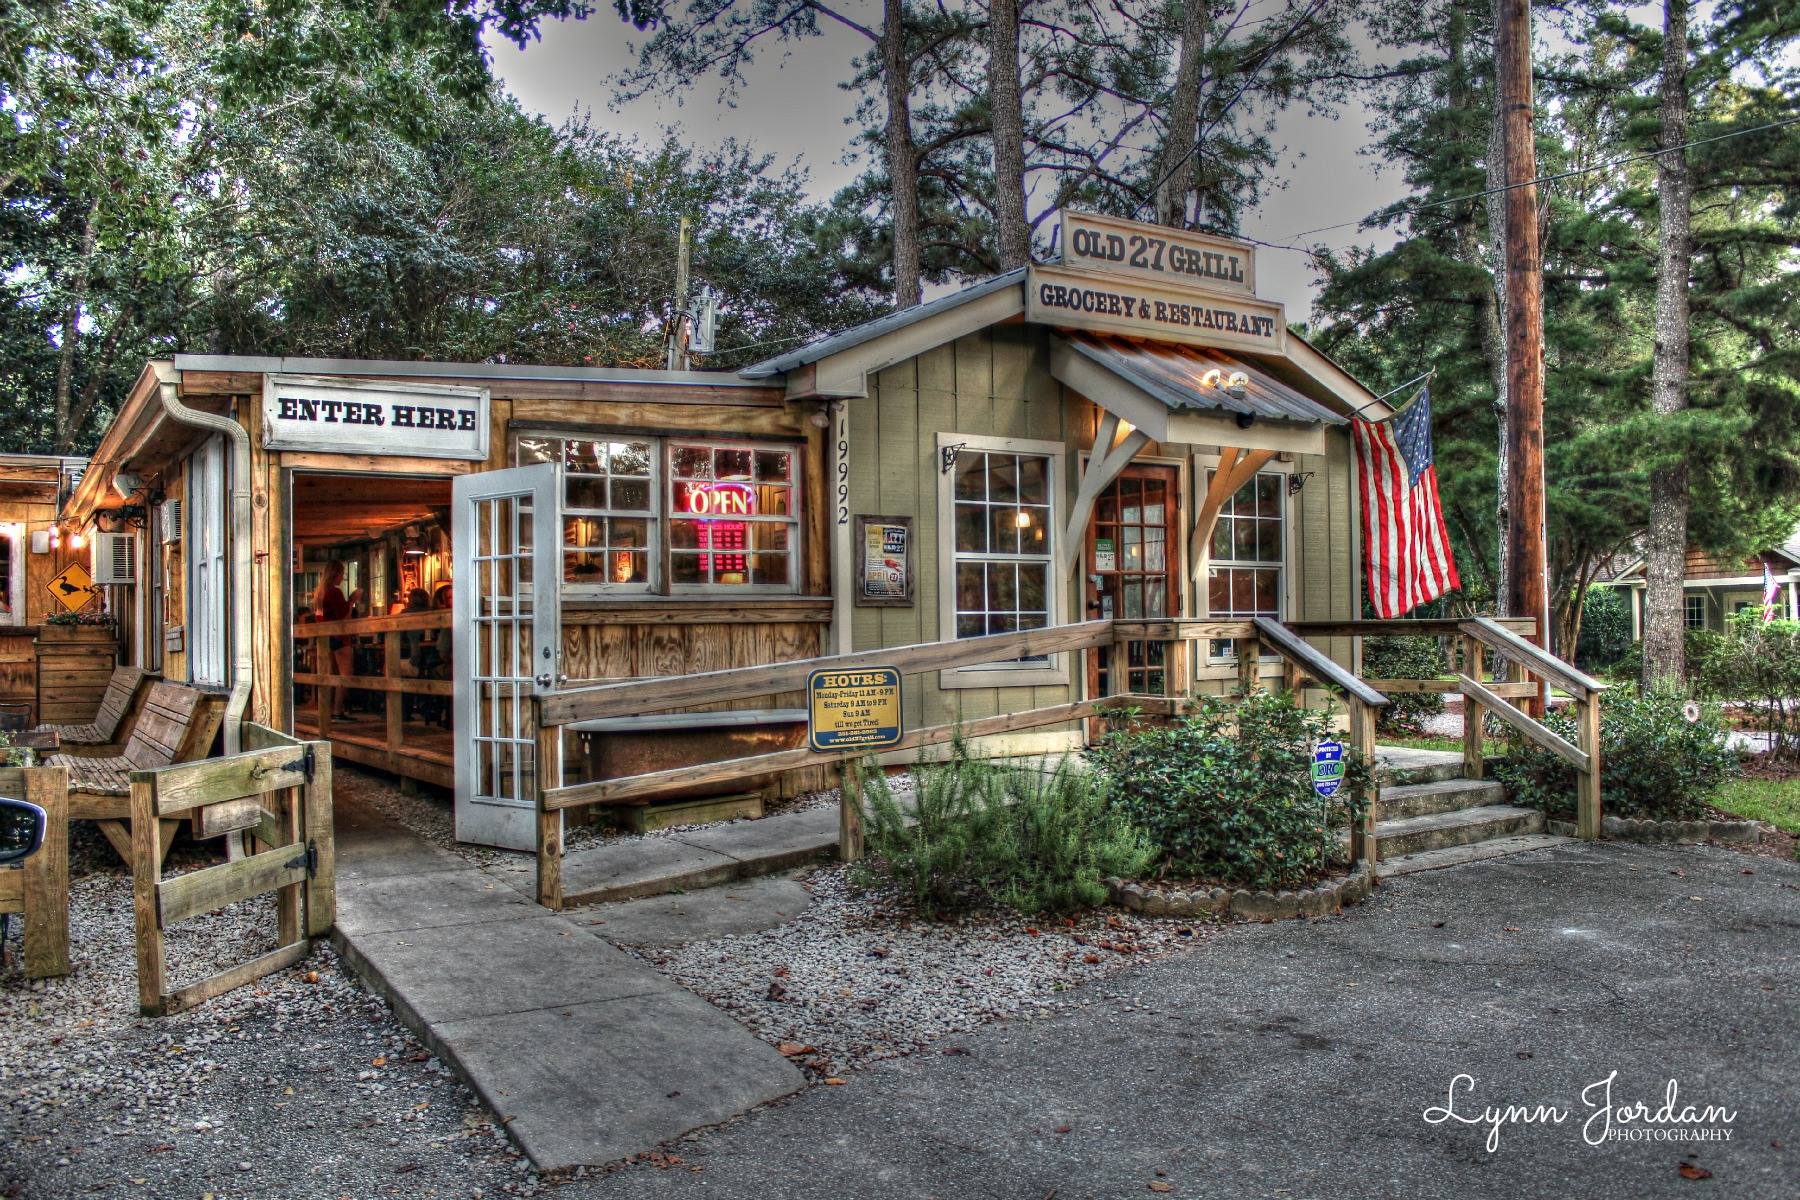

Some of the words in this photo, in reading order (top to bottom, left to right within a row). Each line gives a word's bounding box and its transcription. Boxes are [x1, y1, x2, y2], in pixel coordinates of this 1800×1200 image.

[1072, 228, 1125, 261] OLD
[1129, 235, 1166, 271] 27
[1168, 244, 1244, 283] GRILL
[1040, 283, 1136, 317] GROCERY
[1138, 298, 1150, 320] &
[1154, 301, 1273, 337] RESTAURANT
[278, 397, 385, 426] ENTER
[391, 405, 476, 431] HERE
[838, 418, 848, 525] 19992
[690, 490, 747, 514] OPEN
[823, 673, 887, 687] HOURS:
[824, 700, 849, 709] Saturday
[859, 689, 865, 697] 11
[854, 720, 862, 728] get
